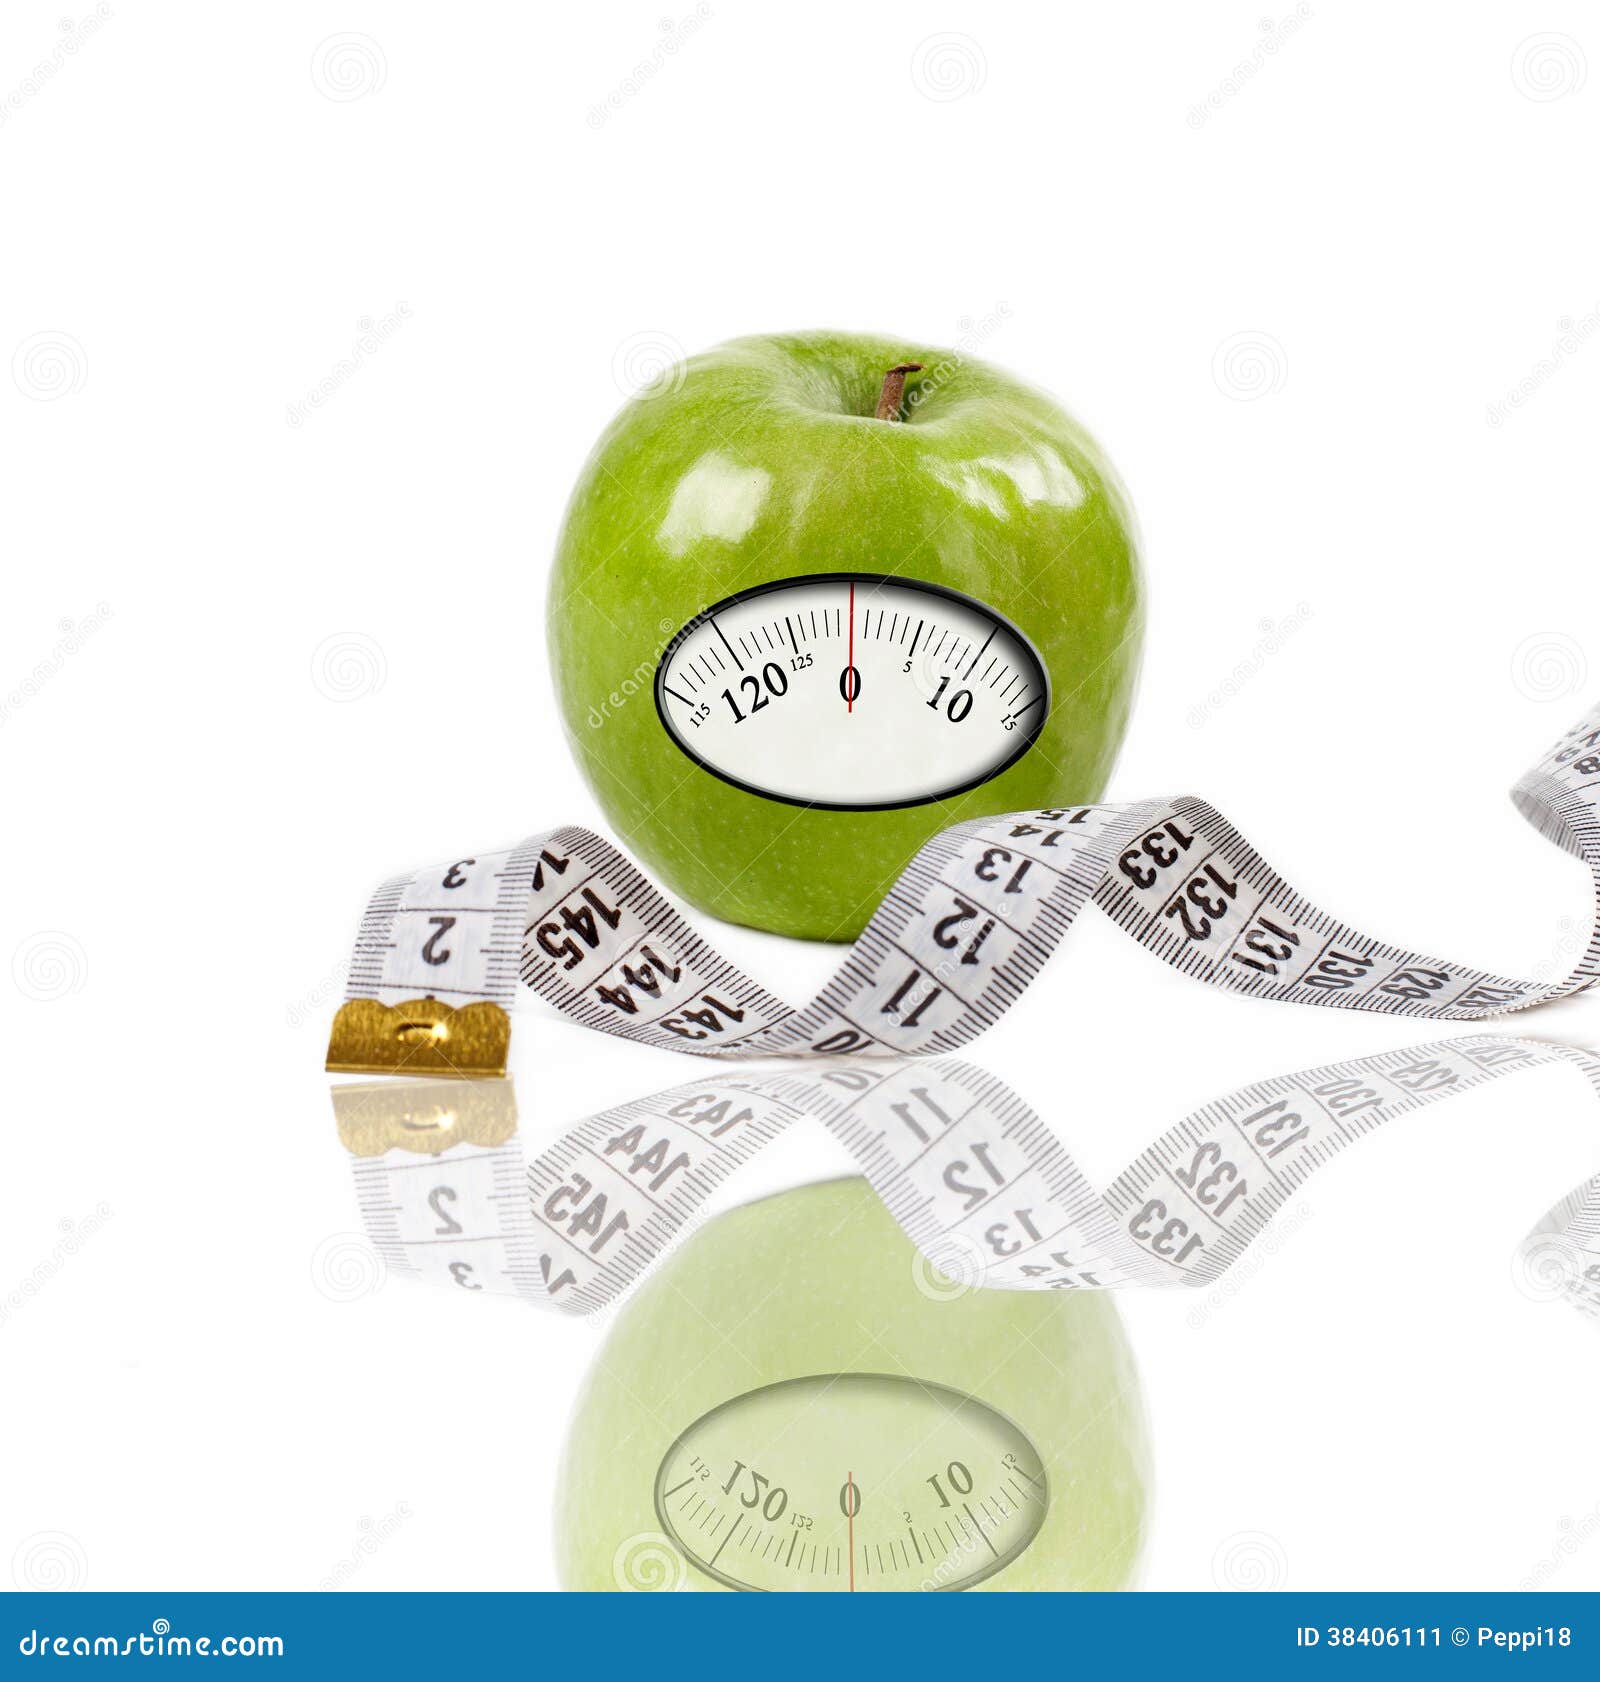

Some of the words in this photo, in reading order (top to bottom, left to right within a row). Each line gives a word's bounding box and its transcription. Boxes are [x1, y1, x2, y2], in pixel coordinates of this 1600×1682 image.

[790, 653, 814, 672] 125
[839, 665, 861, 703] 0
[902, 660, 913, 673] 5
[721, 662, 789, 724] 120
[926, 676, 974, 723] 10
[689, 704, 711, 729] 115
[1000, 713, 1017, 731] 15
[1008, 824, 1066, 848] 14
[1118, 822, 1195, 890] 133
[442, 859, 476, 889] 3
[974, 848, 1033, 894] 13
[1165, 864, 1238, 941] 132
[421, 917, 457, 966] 2
[536, 887, 622, 970] 145
[933, 897, 996, 965] 12
[1231, 917, 1301, 976] 131
[600, 945, 681, 1014] 144
[1304, 950, 1374, 990] 130
[1379, 967, 1452, 1000] 129
[659, 995, 746, 1040] 143
[880, 970, 943, 1027] 11
